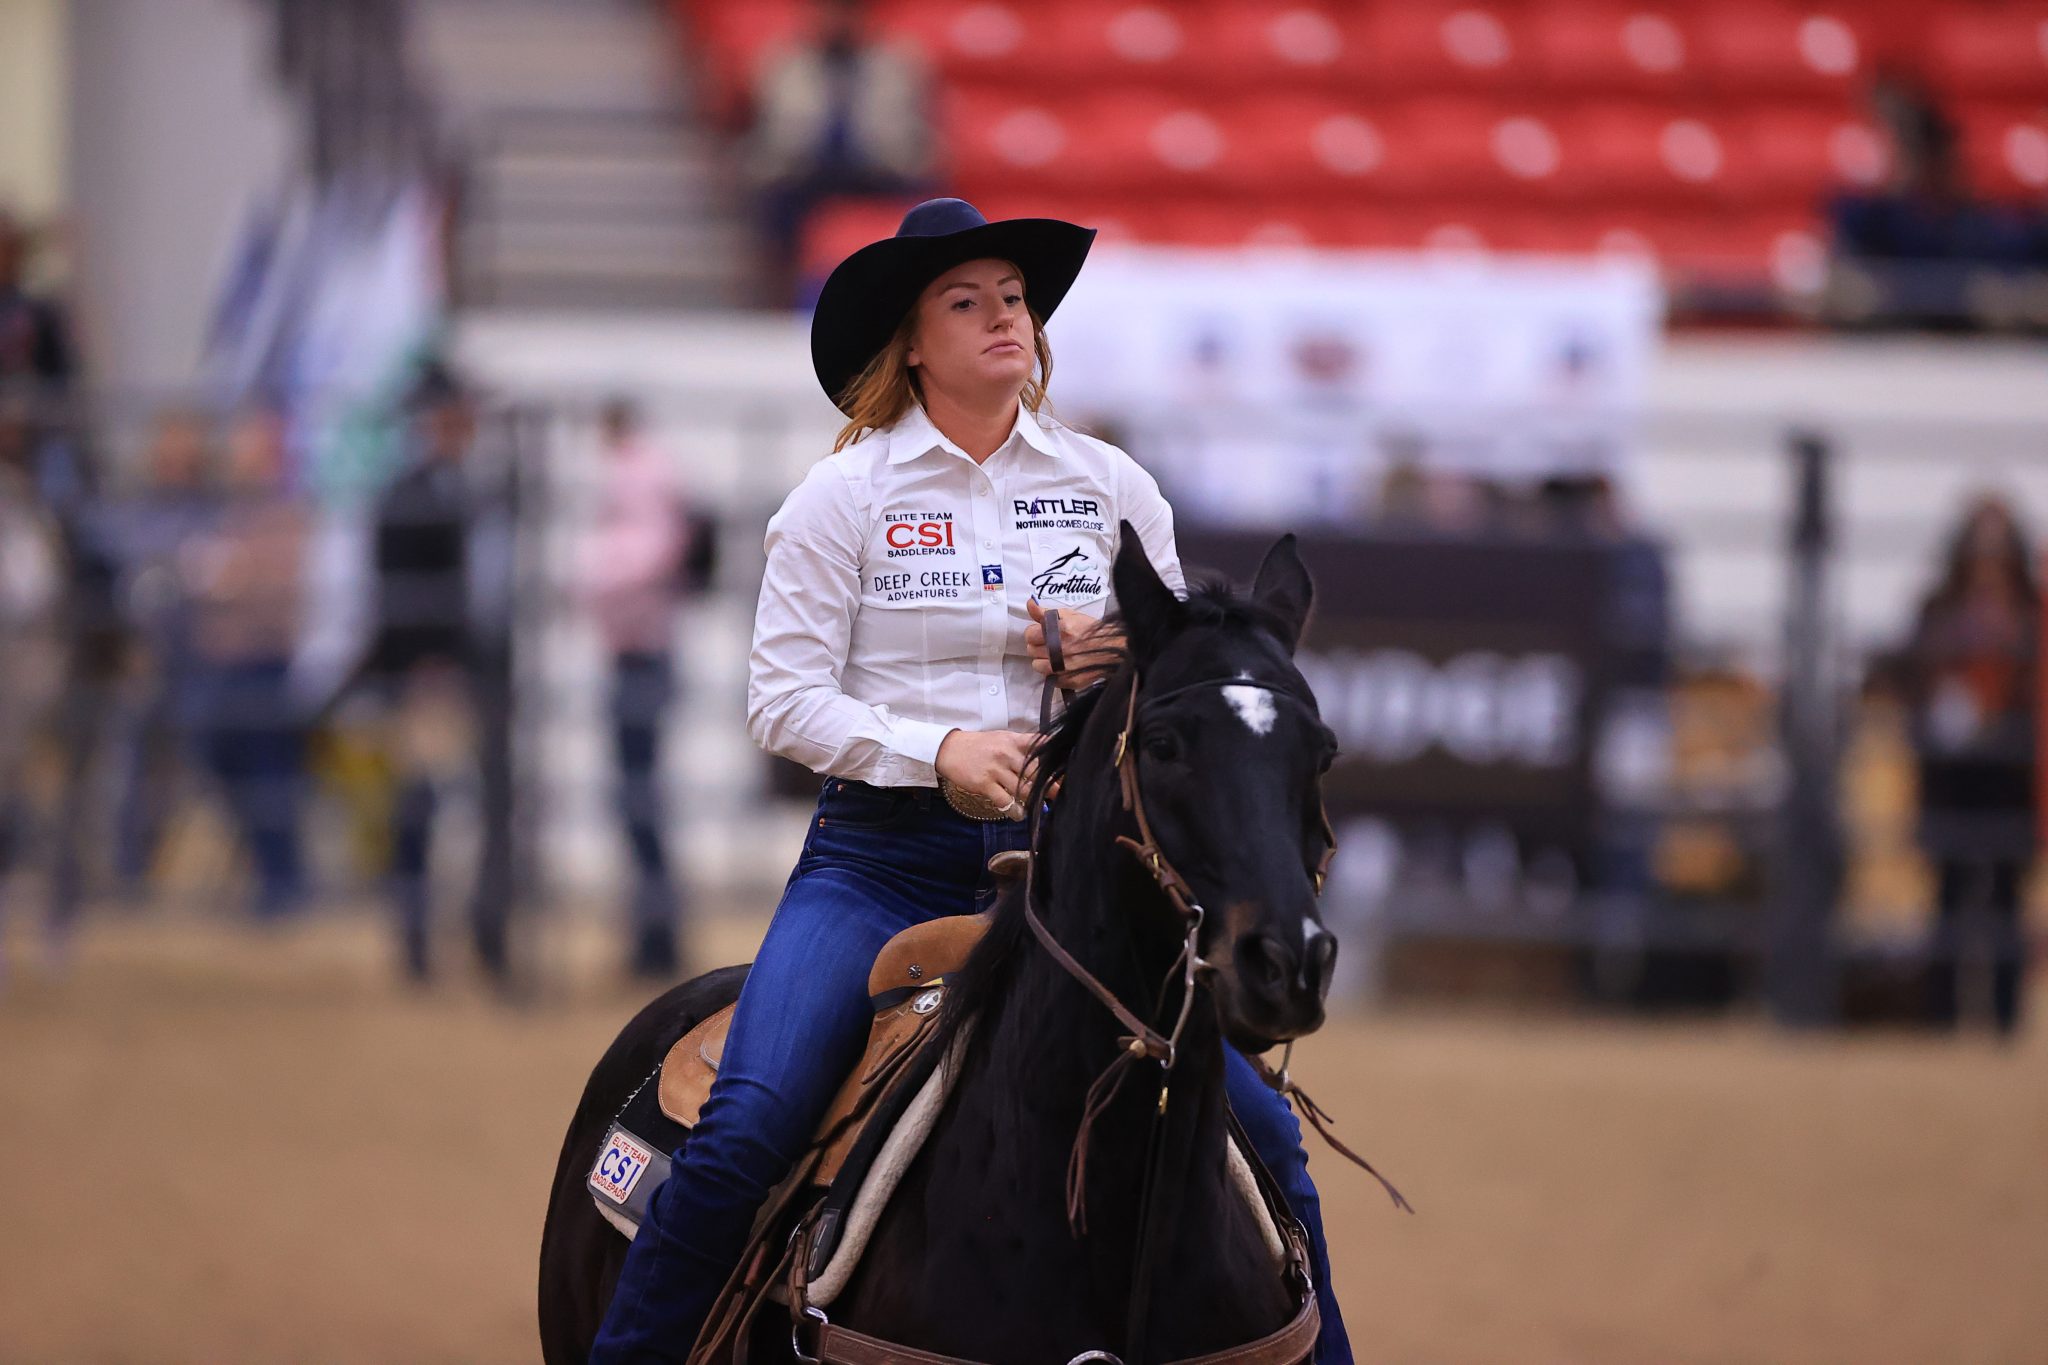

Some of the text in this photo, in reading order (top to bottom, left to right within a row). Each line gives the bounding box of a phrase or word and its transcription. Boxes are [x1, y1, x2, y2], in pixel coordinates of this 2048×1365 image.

[885, 512, 953, 522] ELITE TEAM
[1013, 497, 1099, 517] RATTLER
[886, 521, 954, 549] CSI
[1015, 519, 1104, 532] NOTHING COMES CLOSE
[887, 548, 956, 558] SADDLEPADS
[874, 571, 971, 592] DEEP CREEK
[1031, 572, 1102, 600] Fortitude
[887, 588, 958, 602] ADVENTURES
[612, 1136, 649, 1165] ELITE TEAM
[600, 1148, 641, 1192] CSI
[592, 1172, 627, 1201] SADDLEPADS
